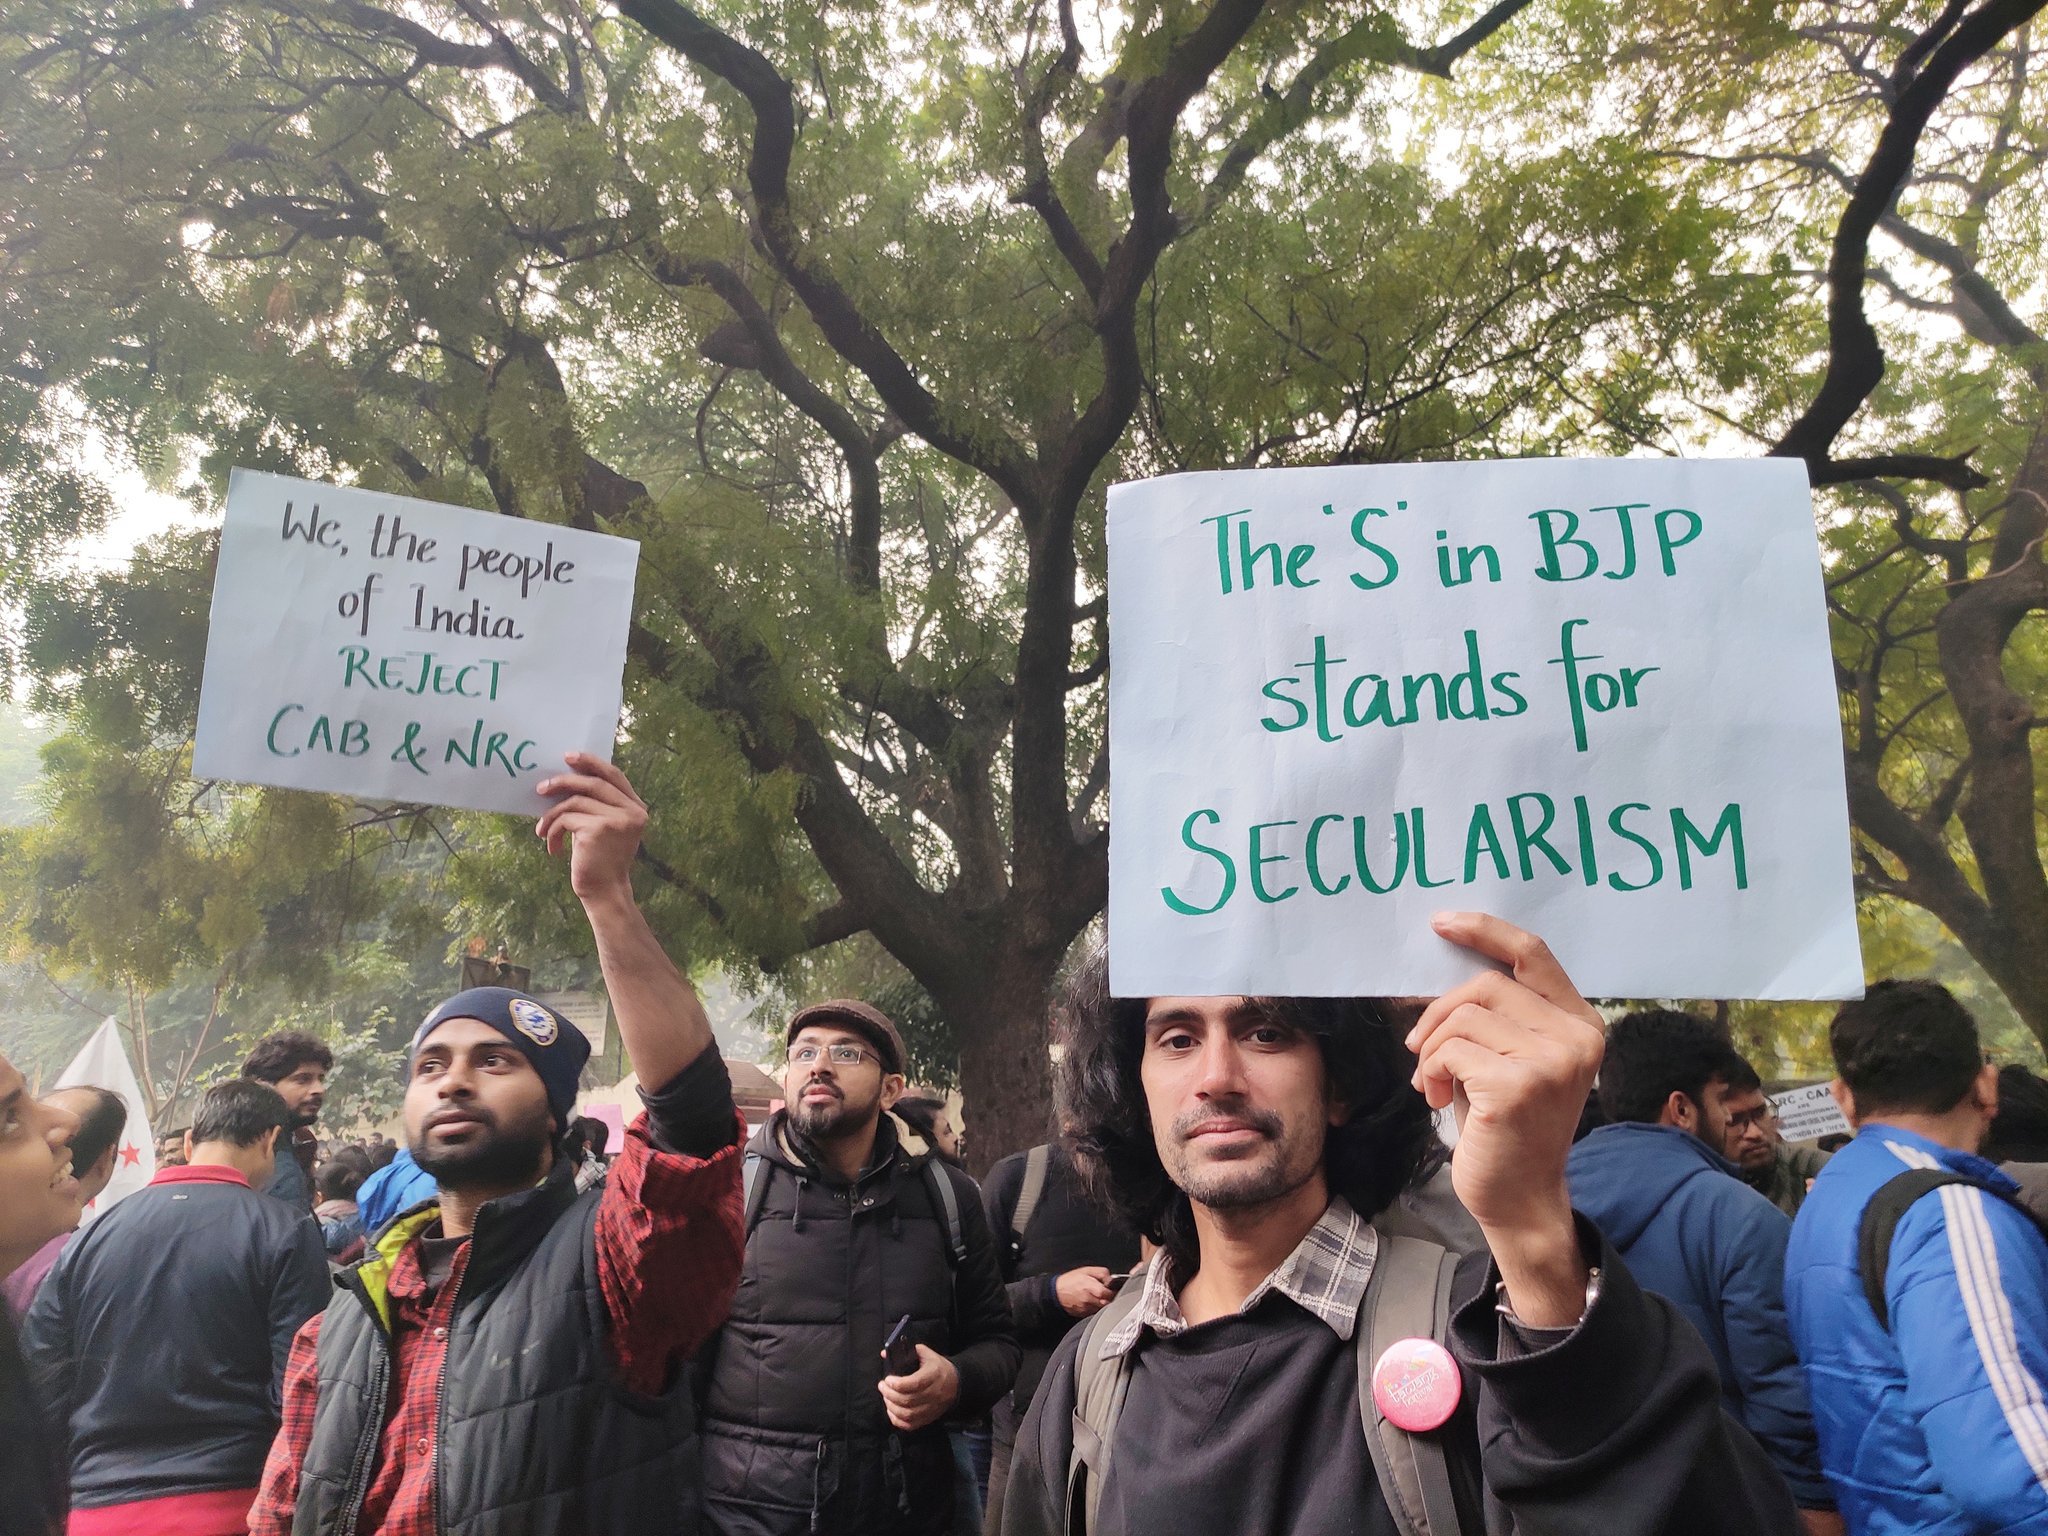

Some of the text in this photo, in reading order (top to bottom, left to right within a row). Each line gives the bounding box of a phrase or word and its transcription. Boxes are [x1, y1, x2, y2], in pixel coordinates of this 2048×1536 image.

[369, 513, 437, 564] the
[458, 541, 575, 599] people
[1201, 509, 1320, 595] The
[1437, 530, 1501, 588] in
[1528, 503, 1702, 582] BJP
[338, 573, 383, 637] of
[338, 645, 510, 701] REJECT
[1261, 619, 1660, 752] stands for
[267, 704, 538, 778] CAB & NRC
[1161, 792, 1748, 915] SECULARISM
